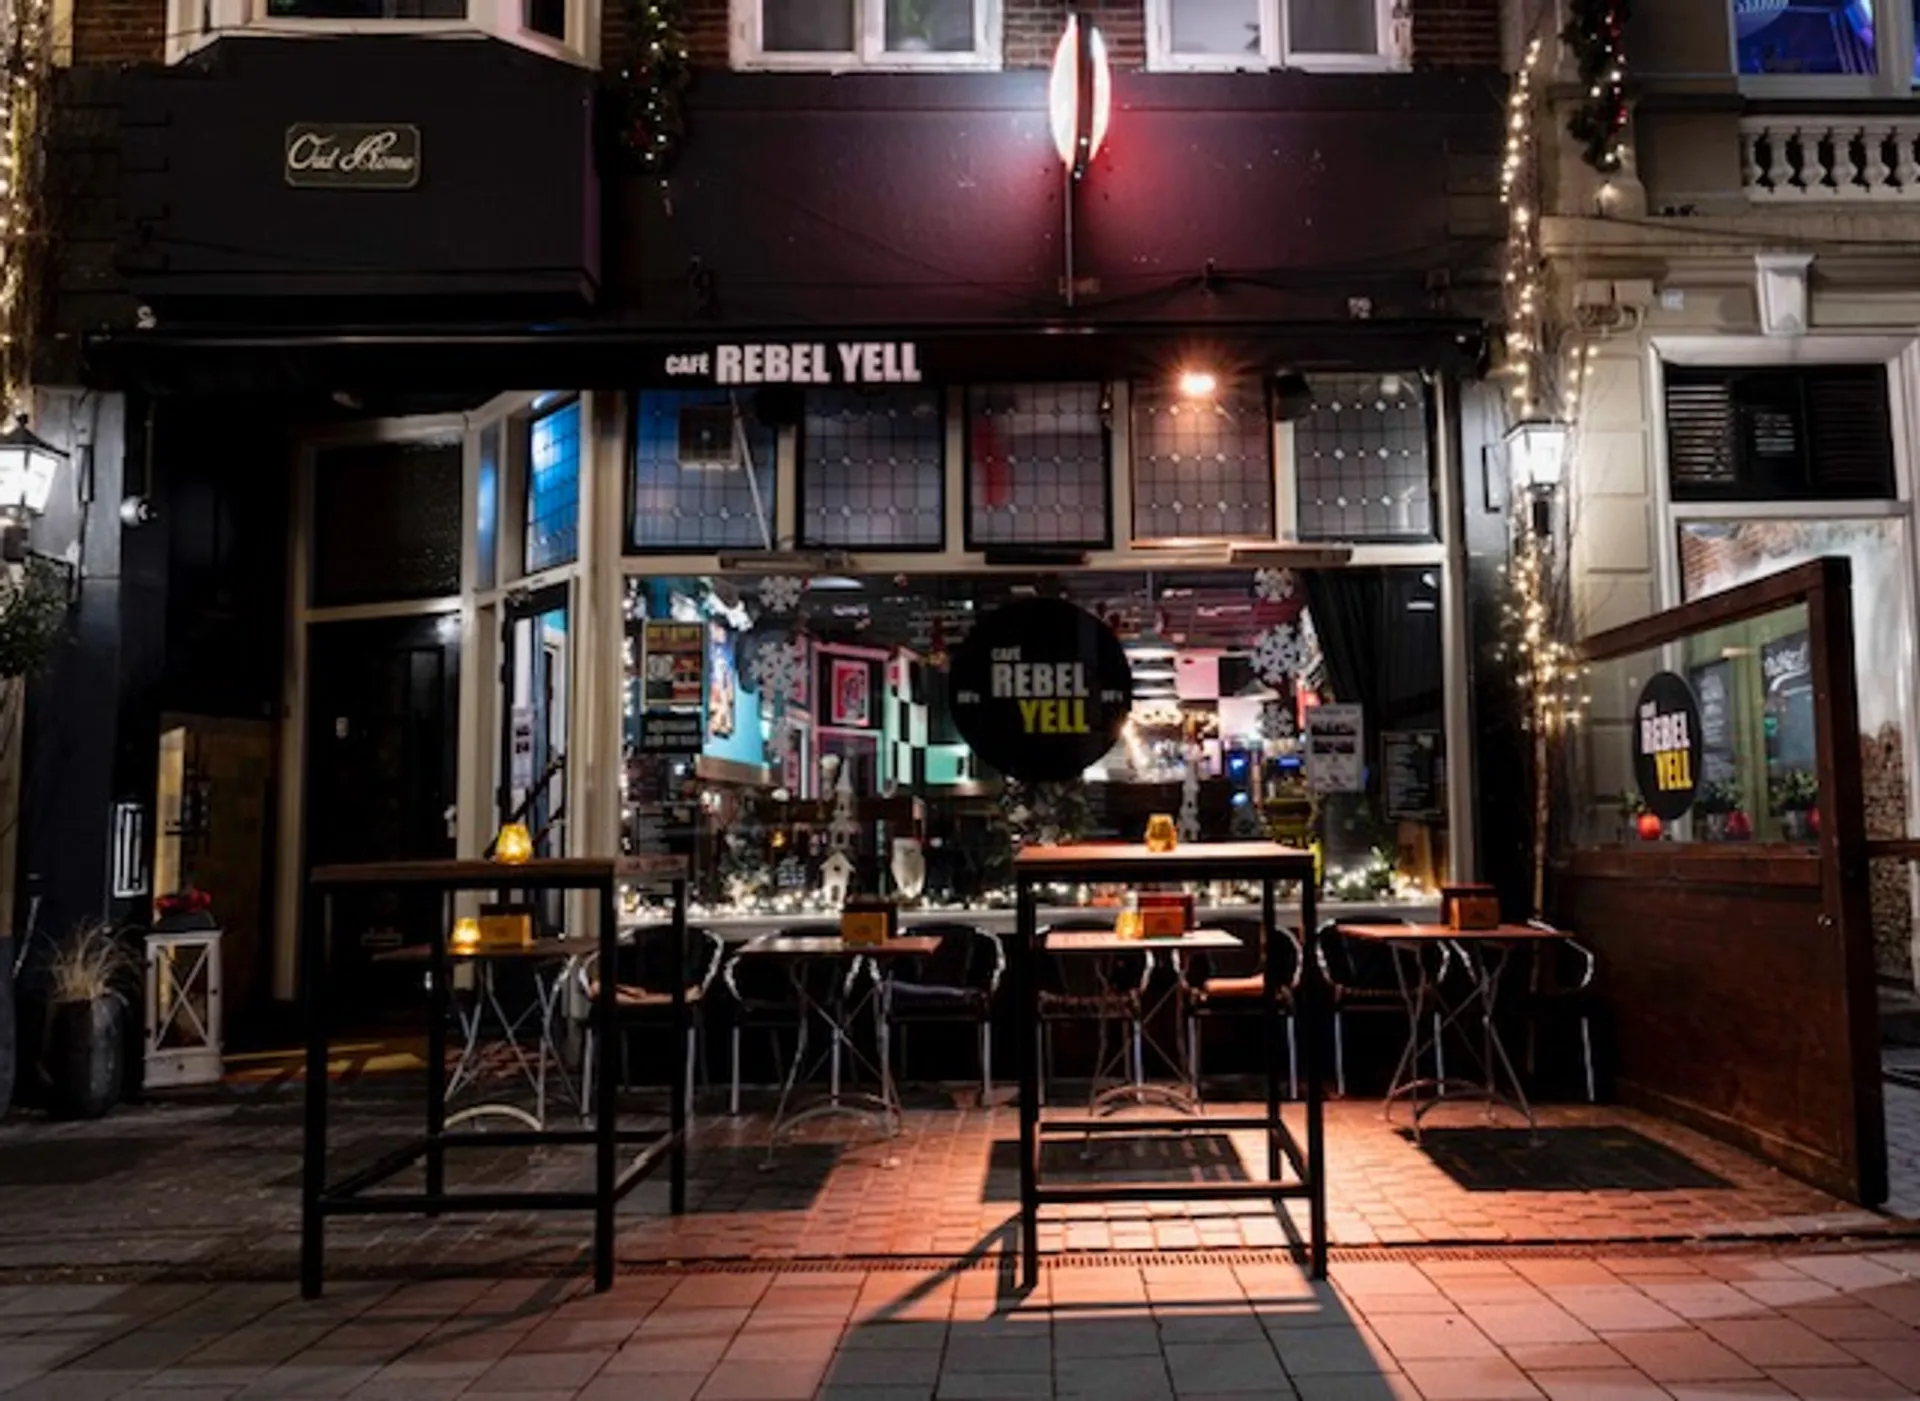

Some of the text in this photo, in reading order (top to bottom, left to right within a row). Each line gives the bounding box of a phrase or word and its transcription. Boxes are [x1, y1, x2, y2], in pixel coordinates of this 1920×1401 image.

[716, 344, 831, 384] REBEL
[838, 342, 922, 383] YELL
[991, 662, 1090, 698] REBEL
[1017, 698, 1091, 735] YELL
[1641, 711, 1691, 755] REBEL
[1654, 748, 1693, 791] YELL
